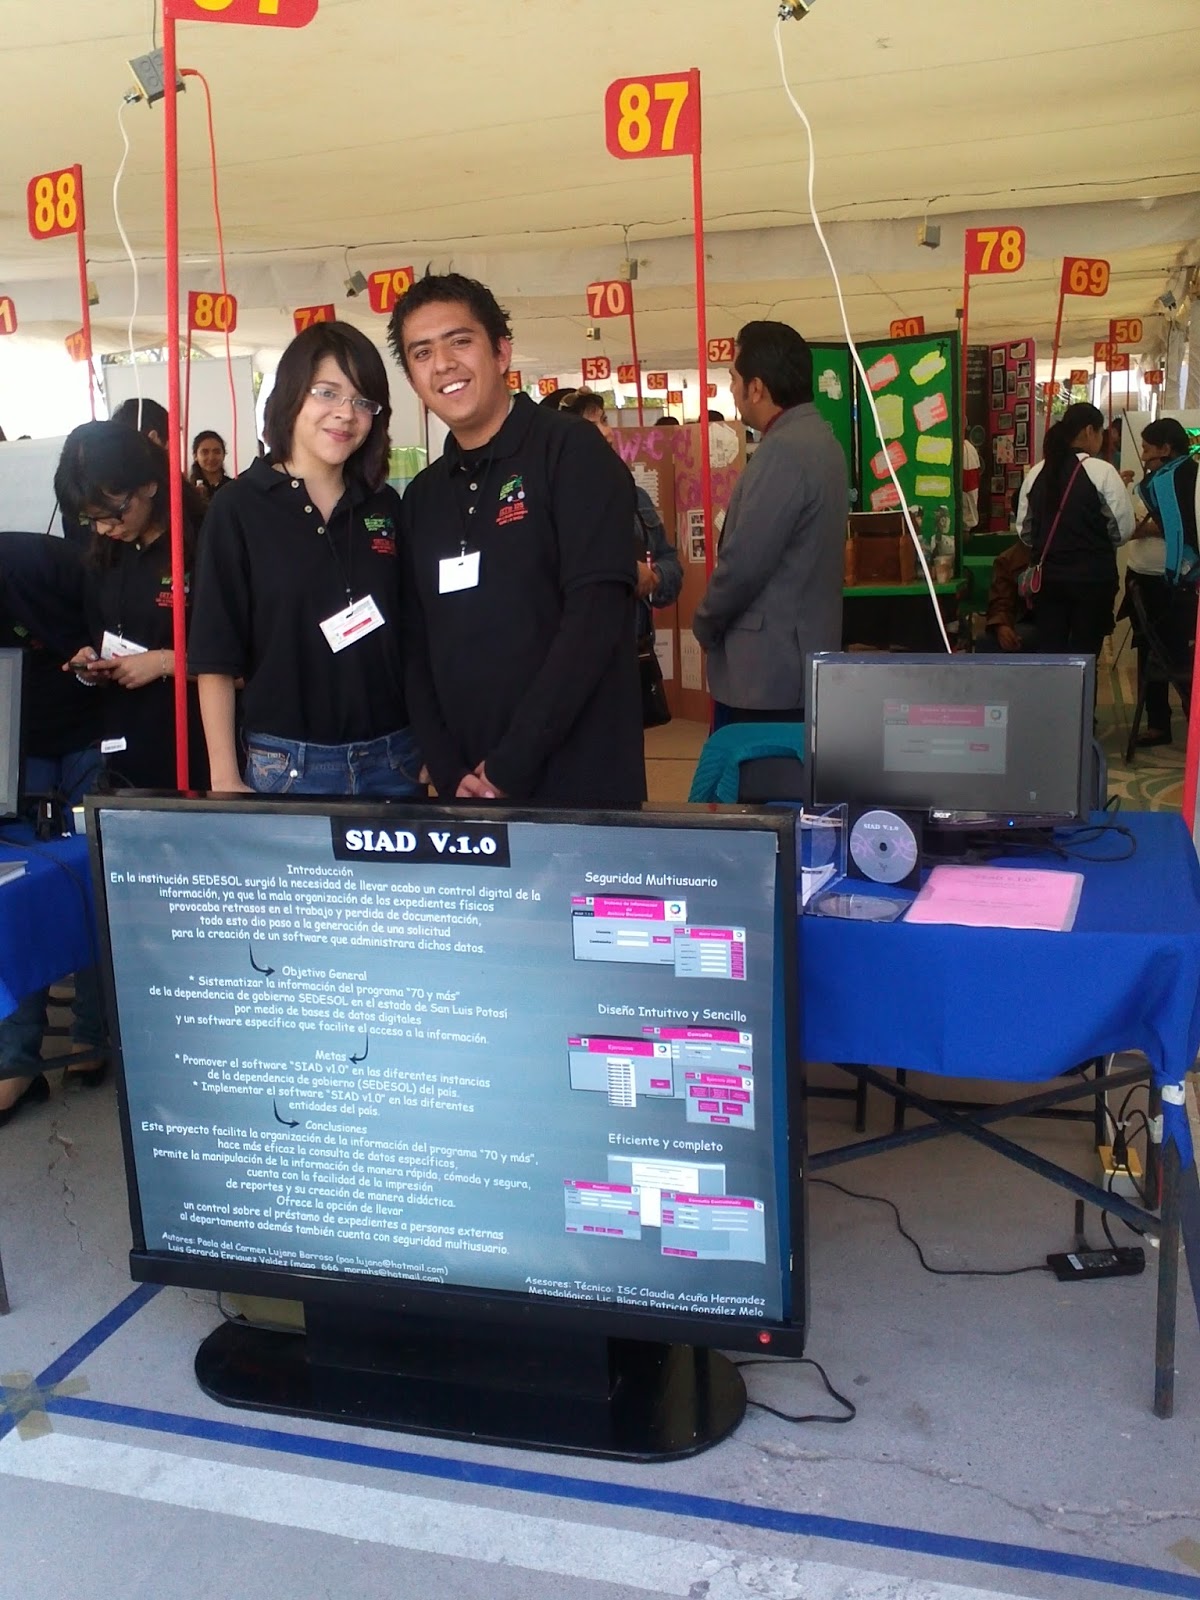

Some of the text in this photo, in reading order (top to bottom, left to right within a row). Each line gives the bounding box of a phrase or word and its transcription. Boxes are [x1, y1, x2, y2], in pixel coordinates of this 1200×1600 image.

[617, 81, 689, 153] 87
[35, 173, 77, 232] 88
[977, 230, 1022, 271] 78
[1069, 260, 1110, 294] 69
[374, 271, 410, 310] 79
[587, 283, 626, 316] 70
[194, 293, 233, 329] 80
[1115, 320, 1142, 343] 50
[708, 340, 731, 361] 52
[586, 359, 609, 380] 53
[618, 366, 636, 383] 44
[1072, 372, 1088, 385] 24
[507, 372, 519, 389] 5
[538, 379, 556, 396] 36
[648, 374, 665, 389] 35
[346, 830, 496, 854] SIAD V.1.0
[287, 864, 353, 877] Introducción
[585, 872, 718, 887] Seguridad Multiusuario
[138, 874, 512, 900] institución SEDESOL surgió necesidad llevar control digital
[169, 902, 219, 913] provocaba
[222, 904, 265, 914] retrasos
[296, 905, 333, 919] trabajo
[346, 908, 383, 921] perdida
[295, 892, 358, 905] organización
[394, 896, 456, 910] expedientes
[460, 899, 494, 912] físicos
[314, 922, 451, 937] generación solicitud
[208, 929, 451, 951] creación software administrara dichos
[282, 966, 367, 981] Objetivo General
[199, 976, 404, 997] Sistematizar información programa
[175, 988, 507, 1019] dependencia gobierno SEDESOL estado Luis Potosí
[597, 1003, 747, 1022] Diseño Intuitivo y Sencillo
[198, 1014, 242, 1026] software
[245, 1016, 296, 1029] específico
[319, 1021, 355, 1032] facilite
[370, 1026, 403, 1037] acceso
[379, 1012, 421, 1026] digitales
[315, 1050, 347, 1062] Metas
[183, 1054, 490, 1088] Promover software diferentes instancias
[234, 1072, 416, 1094] dependencia gobierno (SEDESOL)
[201, 1082, 474, 1112] Implementar software diferentes
[289, 1101, 337, 1112] entidades
[305, 1119, 367, 1134] Conclusiones
[142, 1121, 477, 1158] Este proyecto facilita organización información programa
[608, 1133, 723, 1153] Eficiente y completo
[265, 1143, 295, 1154] eficaz
[309, 1147, 349, 1159] consulta
[153, 1148, 188, 1160] permite
[202, 1152, 262, 1165] manipulación
[292, 1158, 349, 1172] información
[444, 1172, 481, 1184] cómoda
[241, 1180, 283, 1192] reportes
[308, 1186, 349, 1198] creación
[312, 1172, 433, 1192] facilidad impresión
[277, 1196, 403, 1215] Ofrece opción llevar
[190, 1213, 254, 1229] departamento
[258, 1220, 292, 1232] además
[296, 1223, 334, 1236] también
[393, 1234, 442, 1248] seguridad
[197, 1202, 503, 1240] control préstamo expedientes personas externas
[168, 1243, 184, 1252] Luis
[197, 1238, 218, 1248] Paola
[235, 1244, 266, 1254] Carmen
[268, 1247, 296, 1258] Lujano
[299, 1251, 334, 1262] Barroso
[618, 1286, 637, 1295] ISC
[640, 1288, 674, 1300] Claudia
[678, 1293, 708, 1302] Acuña
[711, 1294, 766, 1306] Hernandez
[691, 1304, 736, 1315] González
[738, 1307, 764, 1316] Melo
